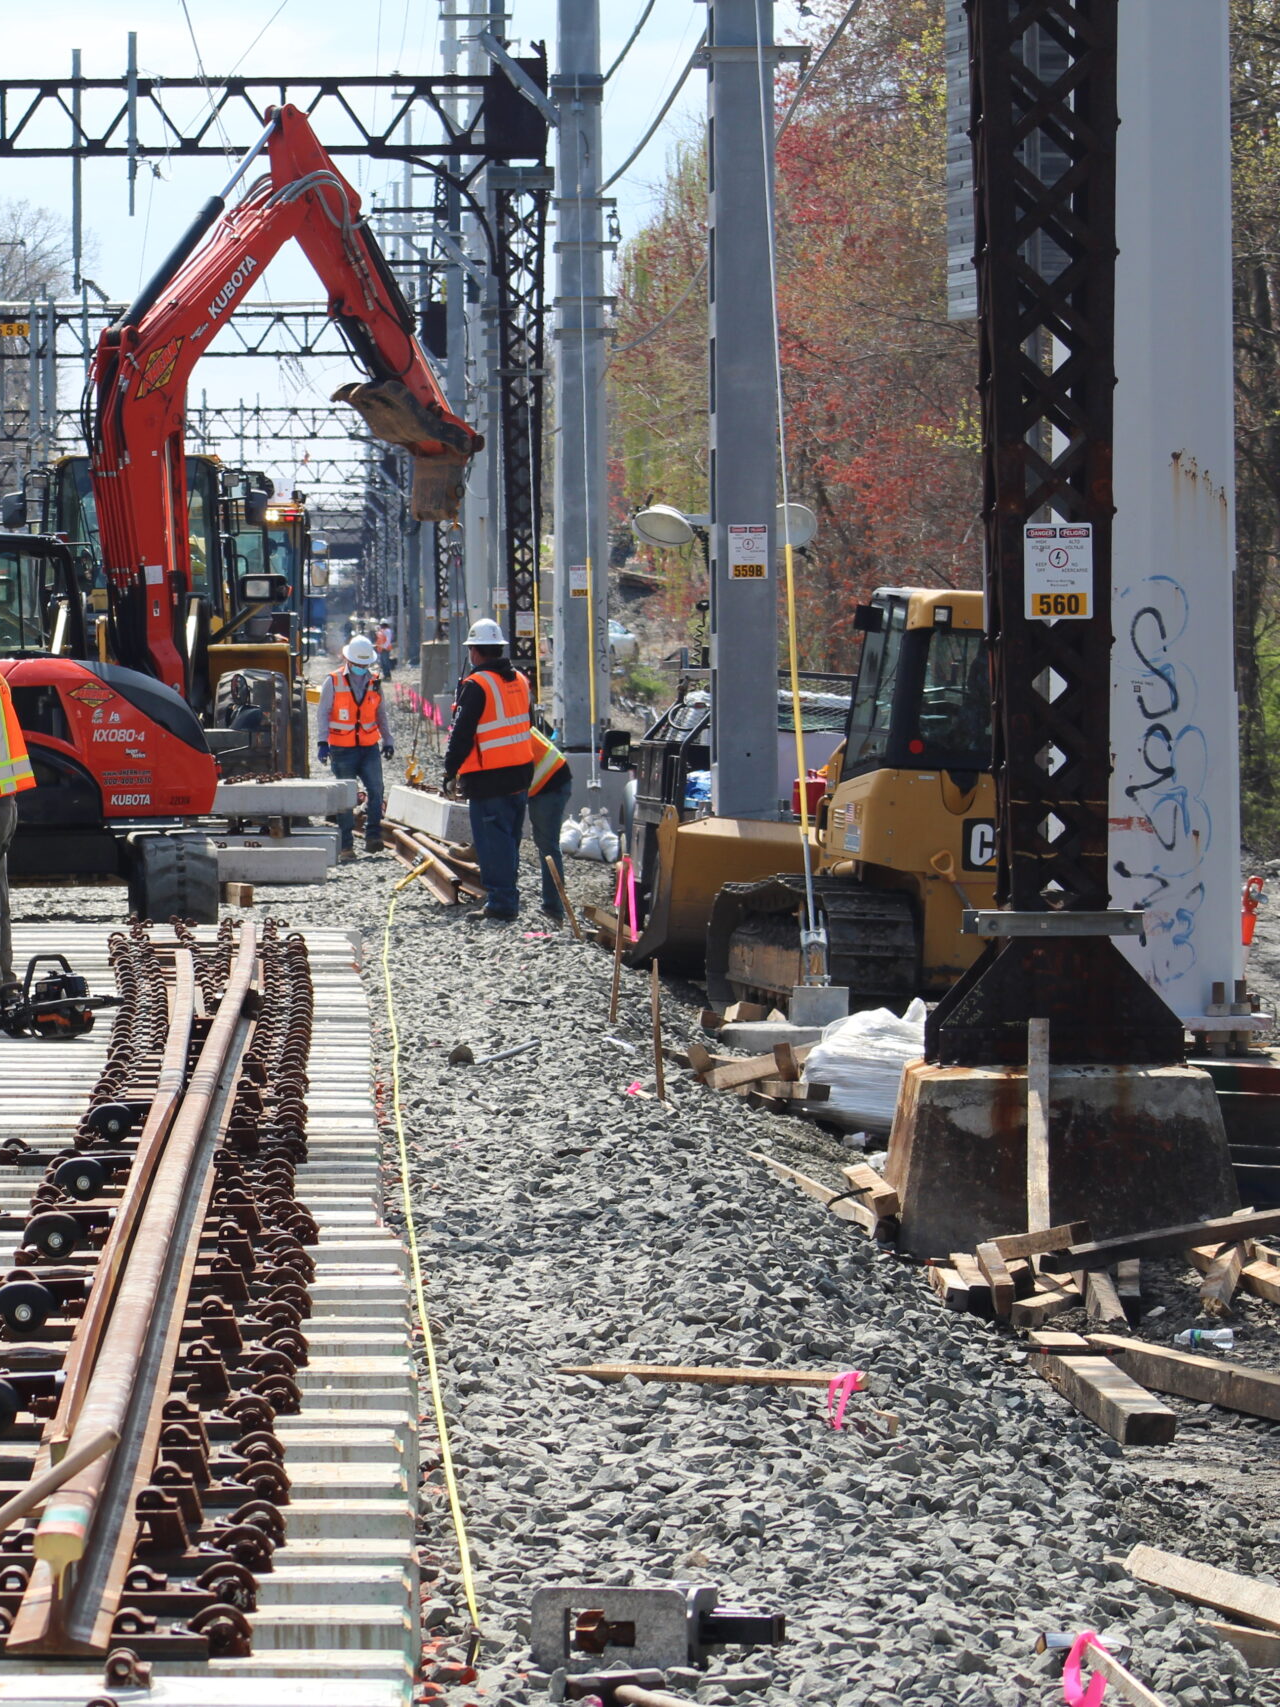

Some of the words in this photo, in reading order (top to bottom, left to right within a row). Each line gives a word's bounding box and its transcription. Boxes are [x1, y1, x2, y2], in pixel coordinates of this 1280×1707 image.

[207, 255, 257, 320] KUBOTA
[734, 564, 763, 577] 559B
[1039, 594, 1080, 616] 560
[92, 729, 145, 743] KX080-4
[111, 794, 151, 806] KUBOTA
